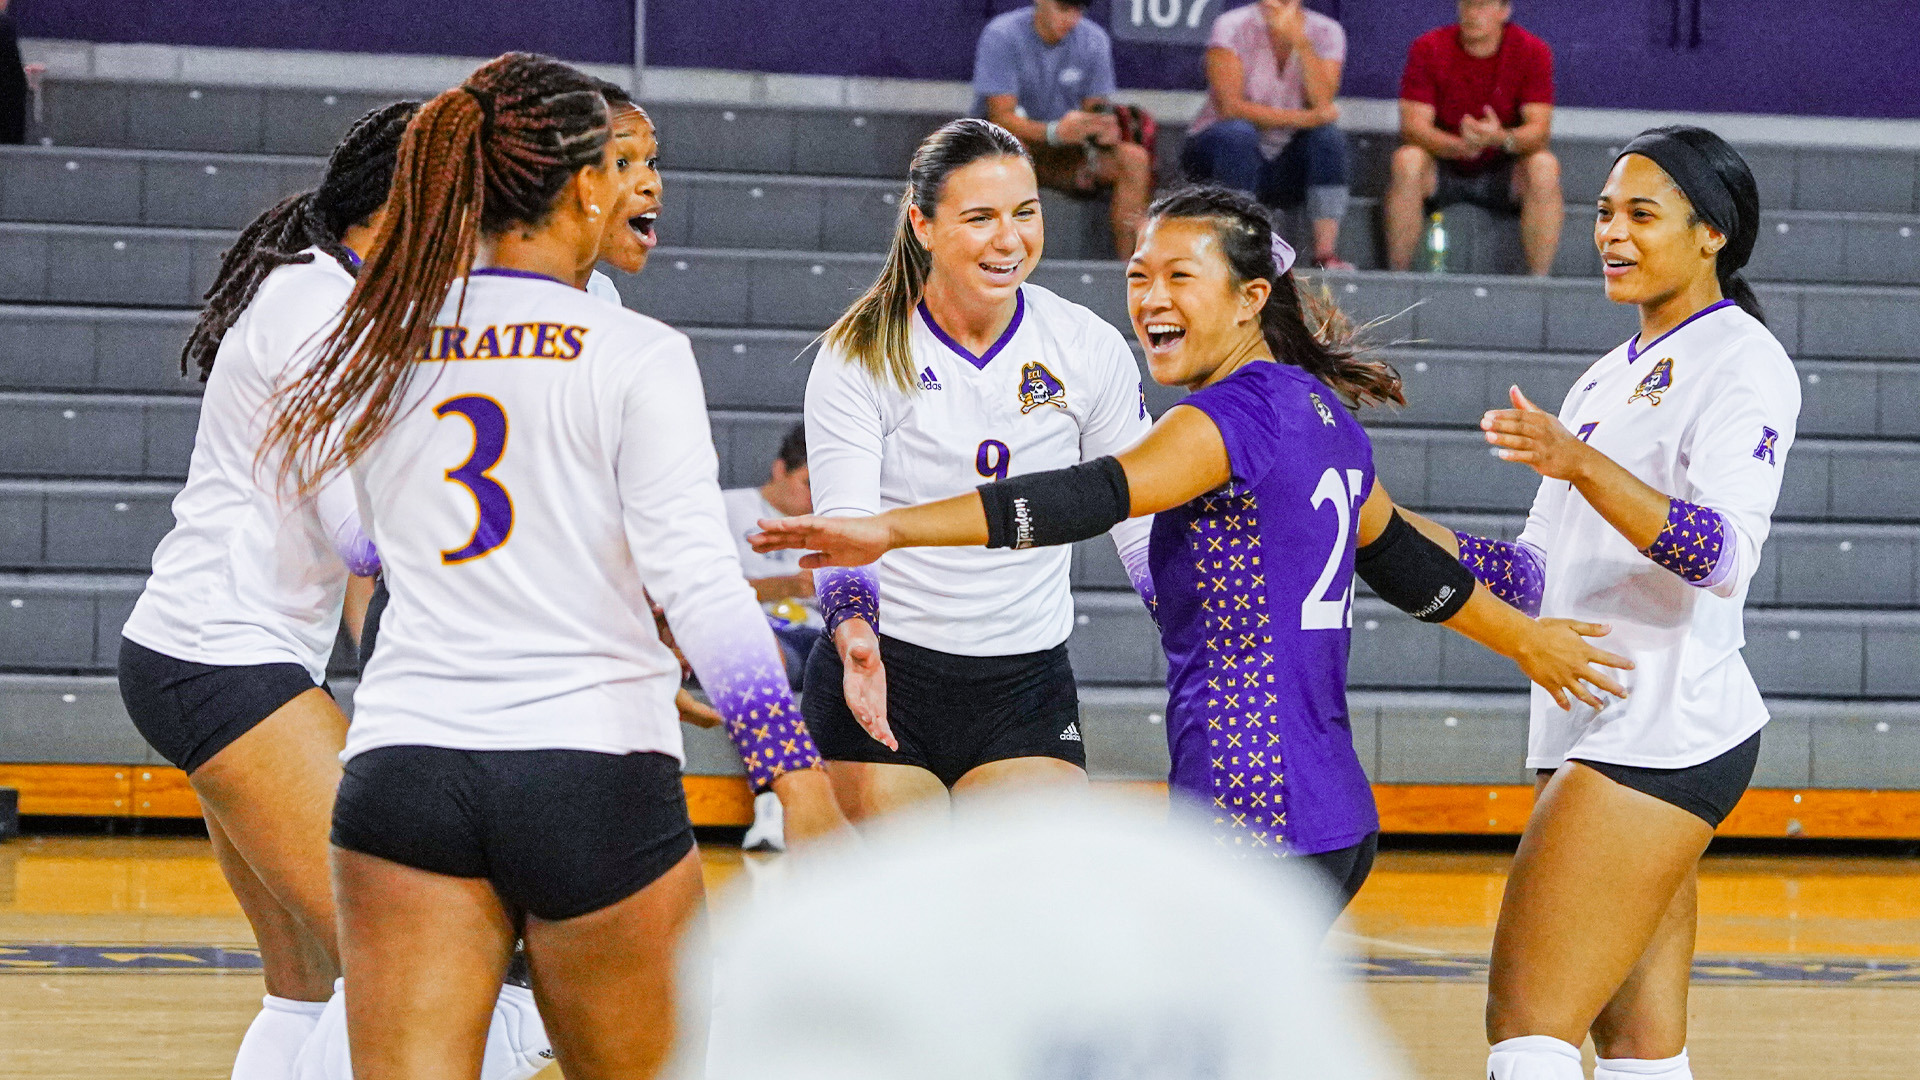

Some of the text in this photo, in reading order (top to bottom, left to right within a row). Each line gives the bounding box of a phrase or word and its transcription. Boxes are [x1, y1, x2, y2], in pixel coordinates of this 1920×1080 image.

[424, 322, 590, 361] IRATES
[1027, 370, 1042, 380] ECU
[432, 393, 515, 565] 3
[975, 439, 1011, 482] 9
